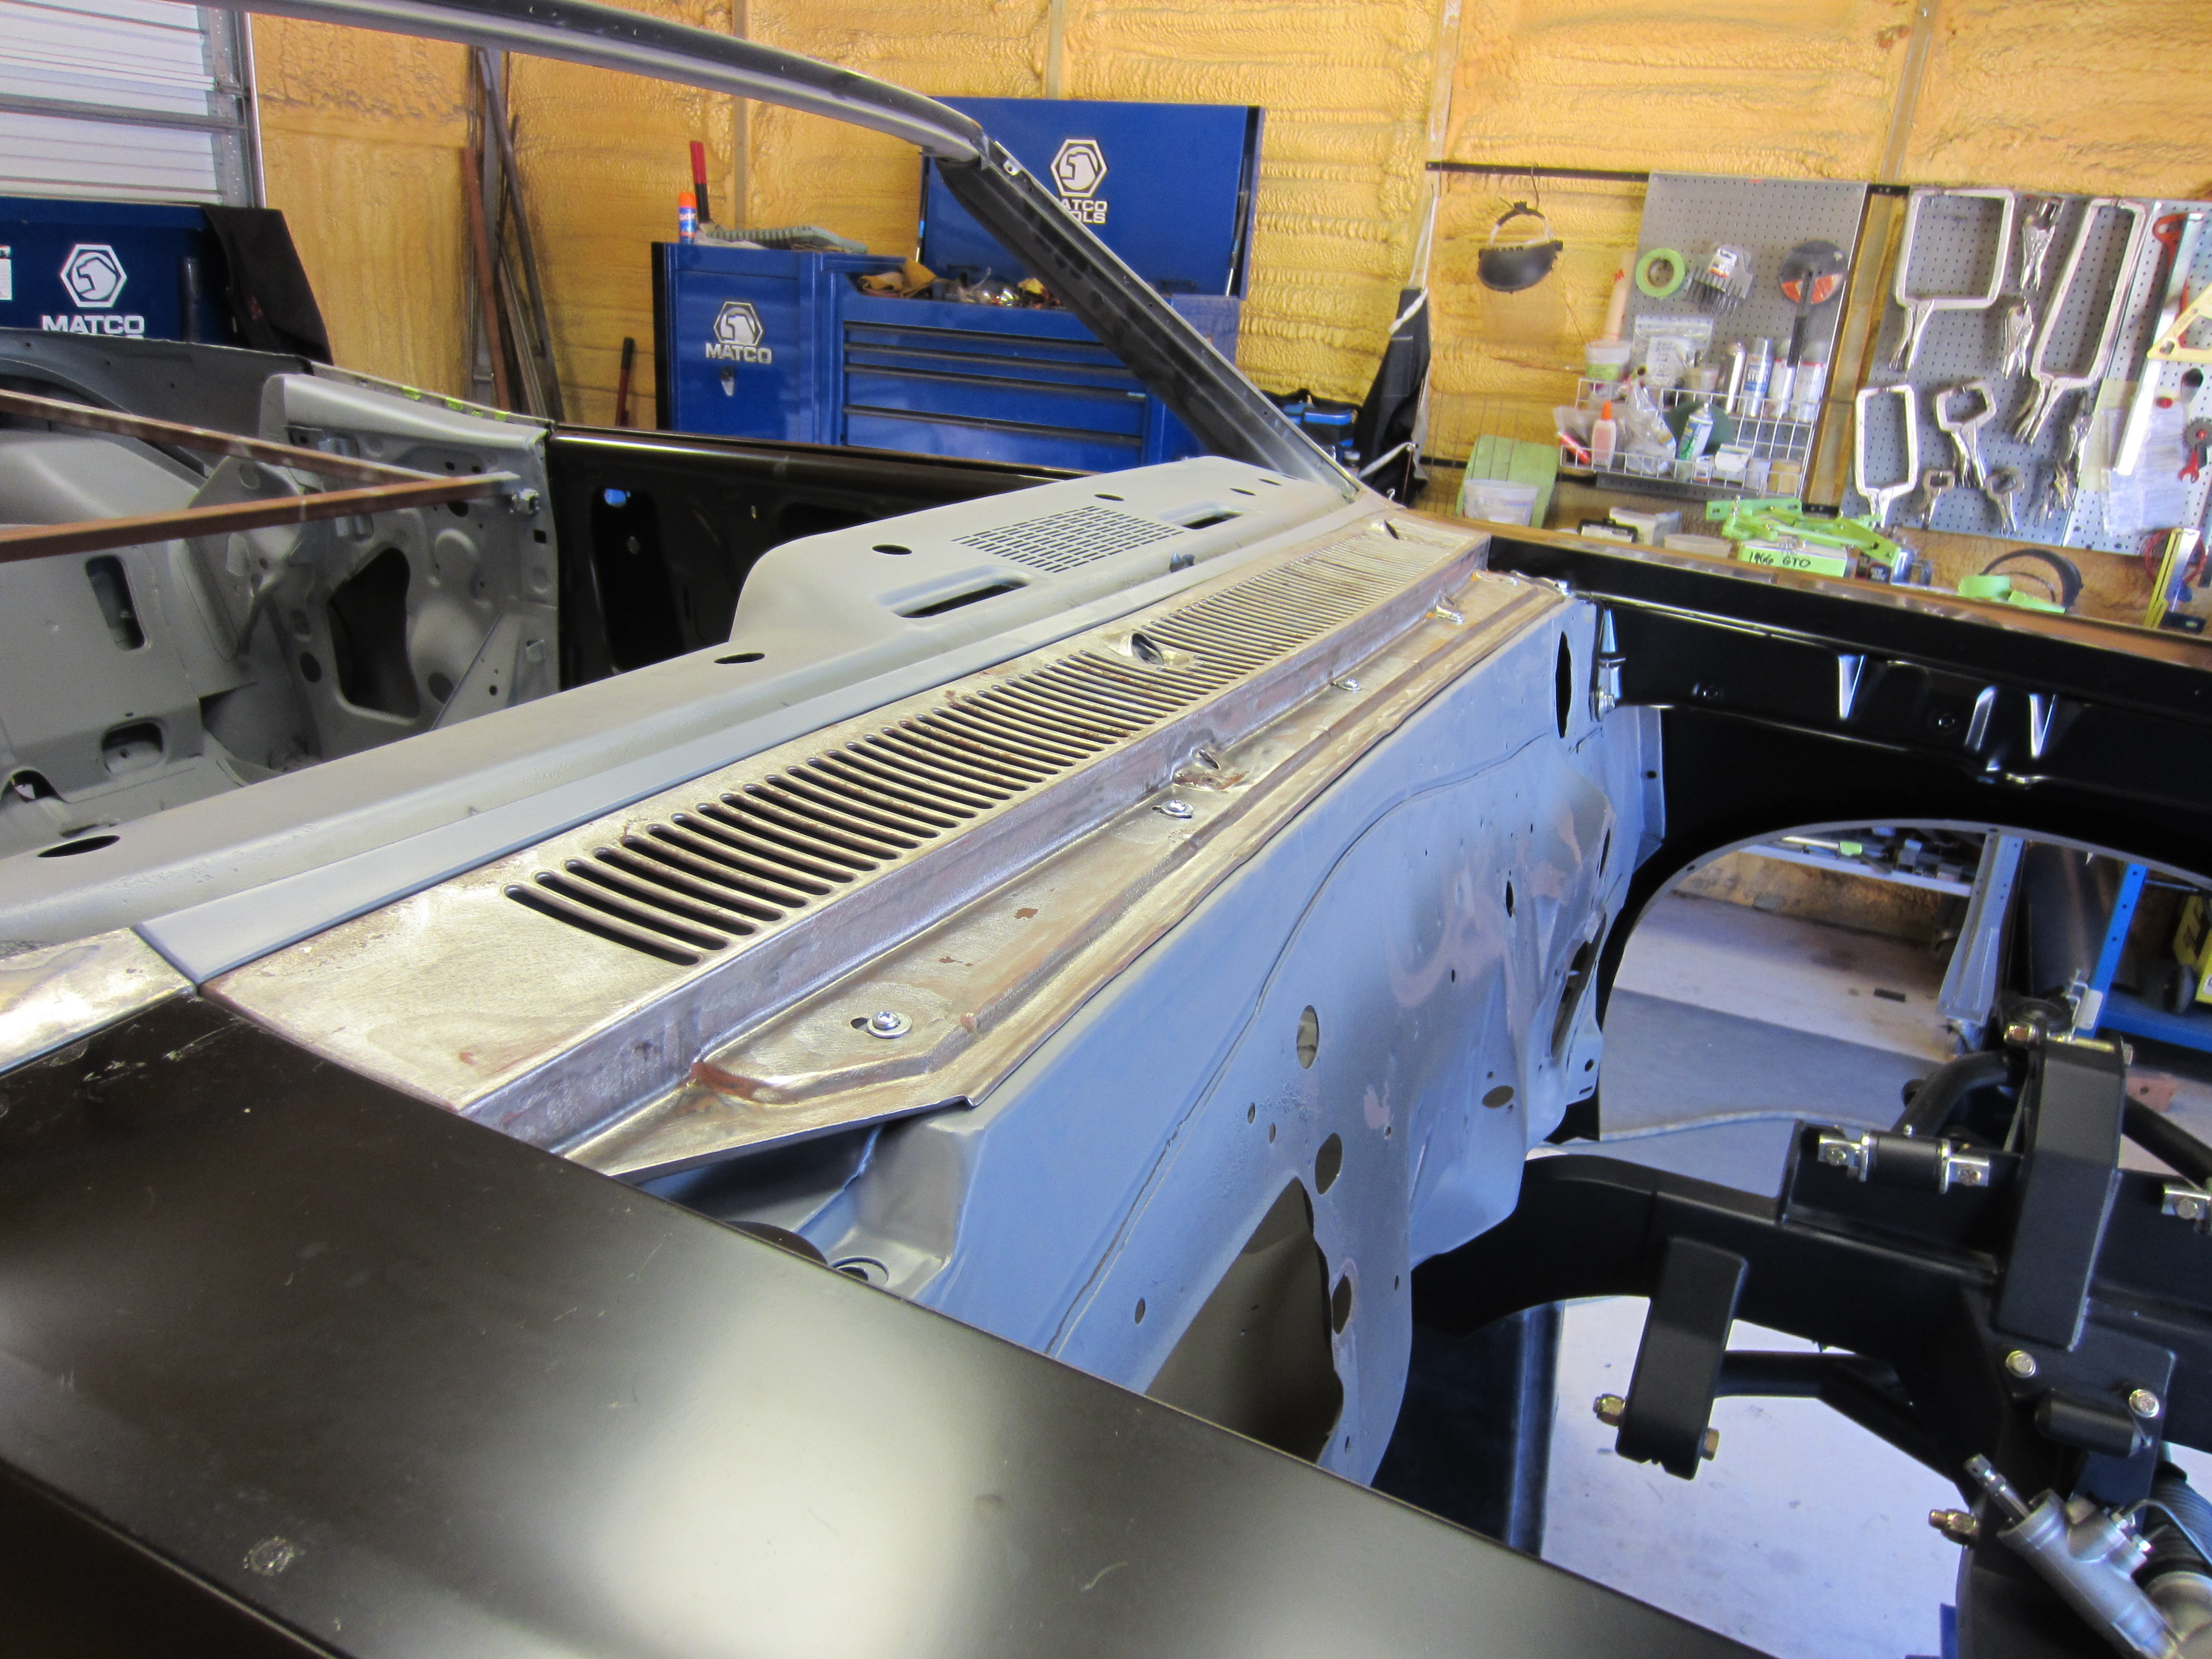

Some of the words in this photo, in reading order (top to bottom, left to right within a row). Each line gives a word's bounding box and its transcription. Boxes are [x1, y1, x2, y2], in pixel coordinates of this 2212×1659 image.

[1061, 199, 1108, 212] ATCO
[1070, 211, 1106, 224] OLS
[41, 315, 145, 335] MATCO
[705, 342, 772, 364] MATCO
[1749, 551, 1775, 565] 1966
[1782, 555, 1812, 568] GTO
